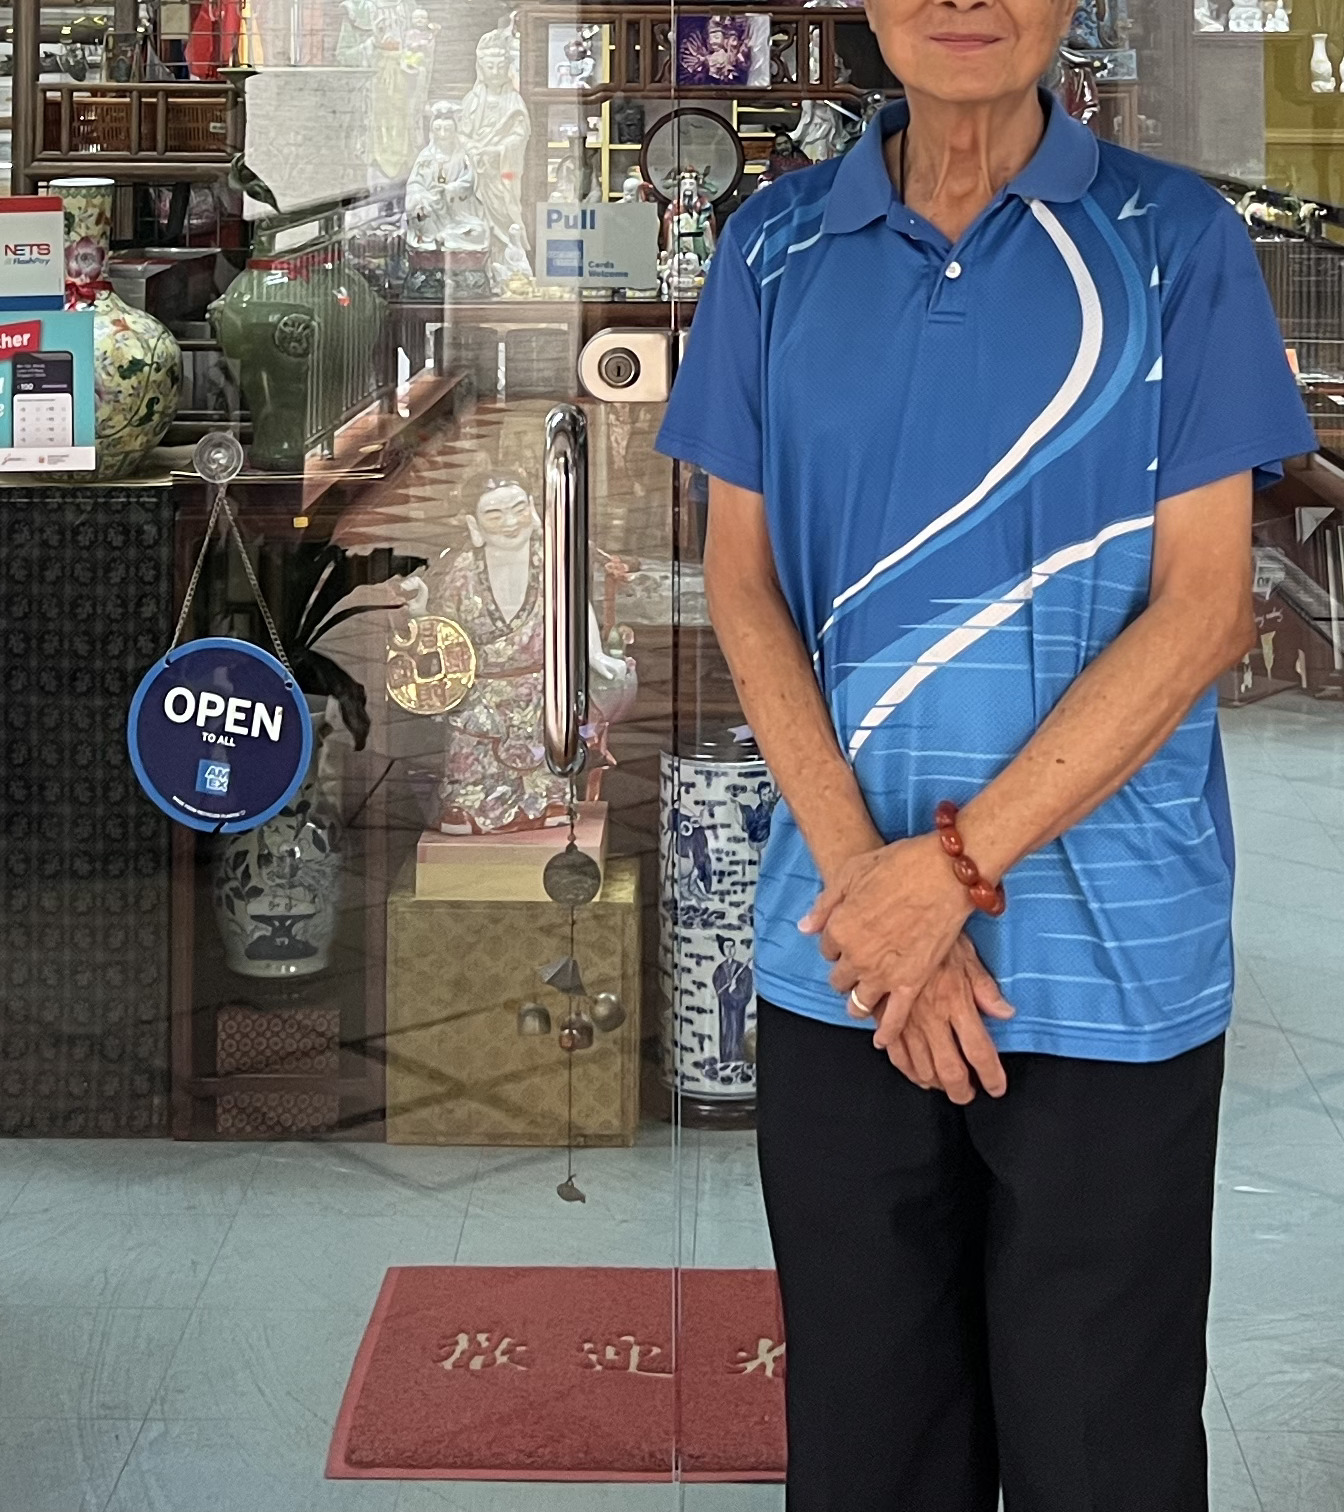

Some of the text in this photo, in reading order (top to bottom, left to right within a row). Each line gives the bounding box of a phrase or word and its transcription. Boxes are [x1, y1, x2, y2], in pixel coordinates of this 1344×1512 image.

[547, 209, 595, 229] Pull
[4, 243, 51, 256] NETS
[588, 260, 614, 269] Cards
[164, 687, 284, 742] OPEN
[202, 732, 236, 748] TO ALL
[207, 767, 230, 779] AM
[209, 778, 228, 789] EX
